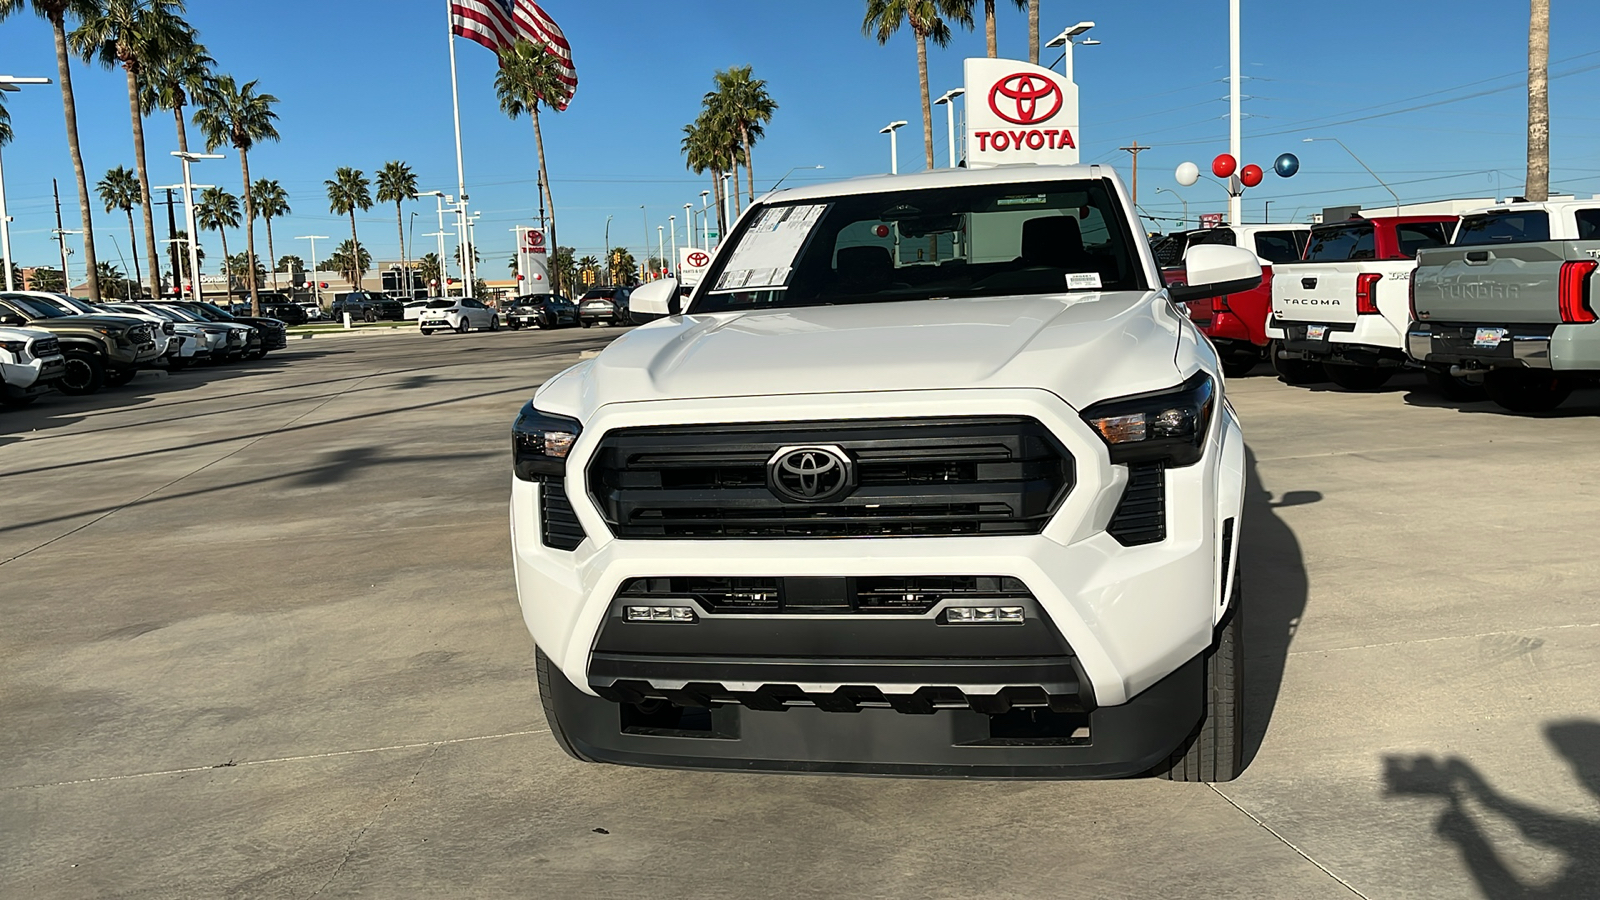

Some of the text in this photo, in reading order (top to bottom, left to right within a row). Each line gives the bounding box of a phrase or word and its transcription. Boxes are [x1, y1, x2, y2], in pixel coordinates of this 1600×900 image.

[974, 129, 1076, 152] TOYOTA
[1437, 282, 1521, 299] TUNDRA
[1283, 298, 1341, 306] TACOMA
